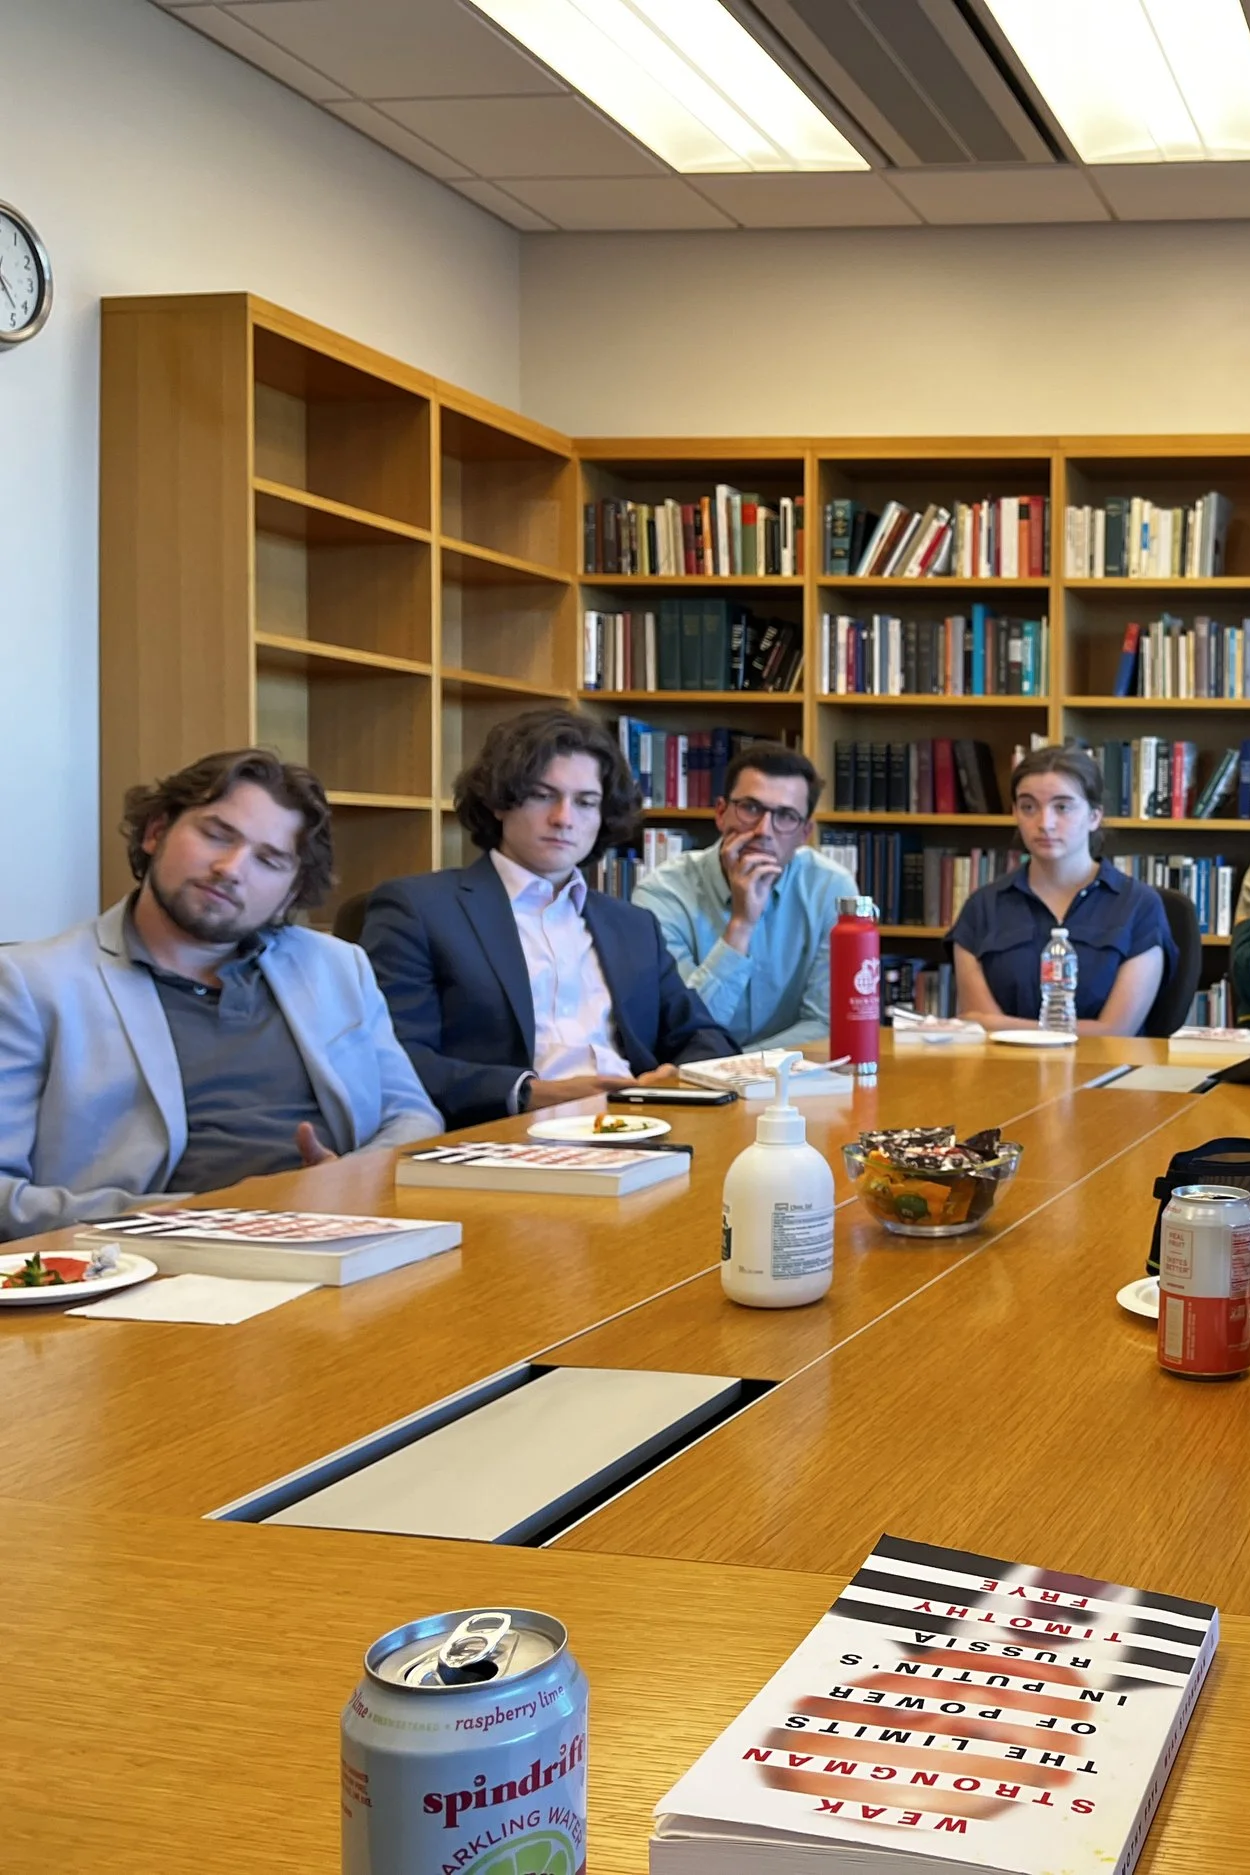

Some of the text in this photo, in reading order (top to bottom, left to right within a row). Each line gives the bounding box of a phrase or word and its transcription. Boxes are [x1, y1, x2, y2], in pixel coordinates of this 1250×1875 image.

[13, 231, 17, 246] 1
[23, 254, 31, 271] 2
[27, 278, 34, 294] 3
[9, 312, 17, 328] 5
[21, 300, 28, 315] 4
[980, 1579, 1088, 1610] FRYE
[912, 1600, 1123, 1643] TIMOTHY
[912, 1631, 1092, 1669] RUSSIA
[839, 1653, 1128, 1707] IN PUTIN'S
[454, 1698, 537, 1732] raspberry
[539, 1685, 565, 1709] lime
[827, 1685, 1098, 1736] OF POWER
[784, 1715, 1099, 1775] THE LIMITS
[423, 1733, 585, 1829] spindrift
[742, 1746, 1096, 1815] STRONGMAN
[813, 1798, 968, 1834] WEAK
[442, 1806, 584, 1875] ARKLING WATER
